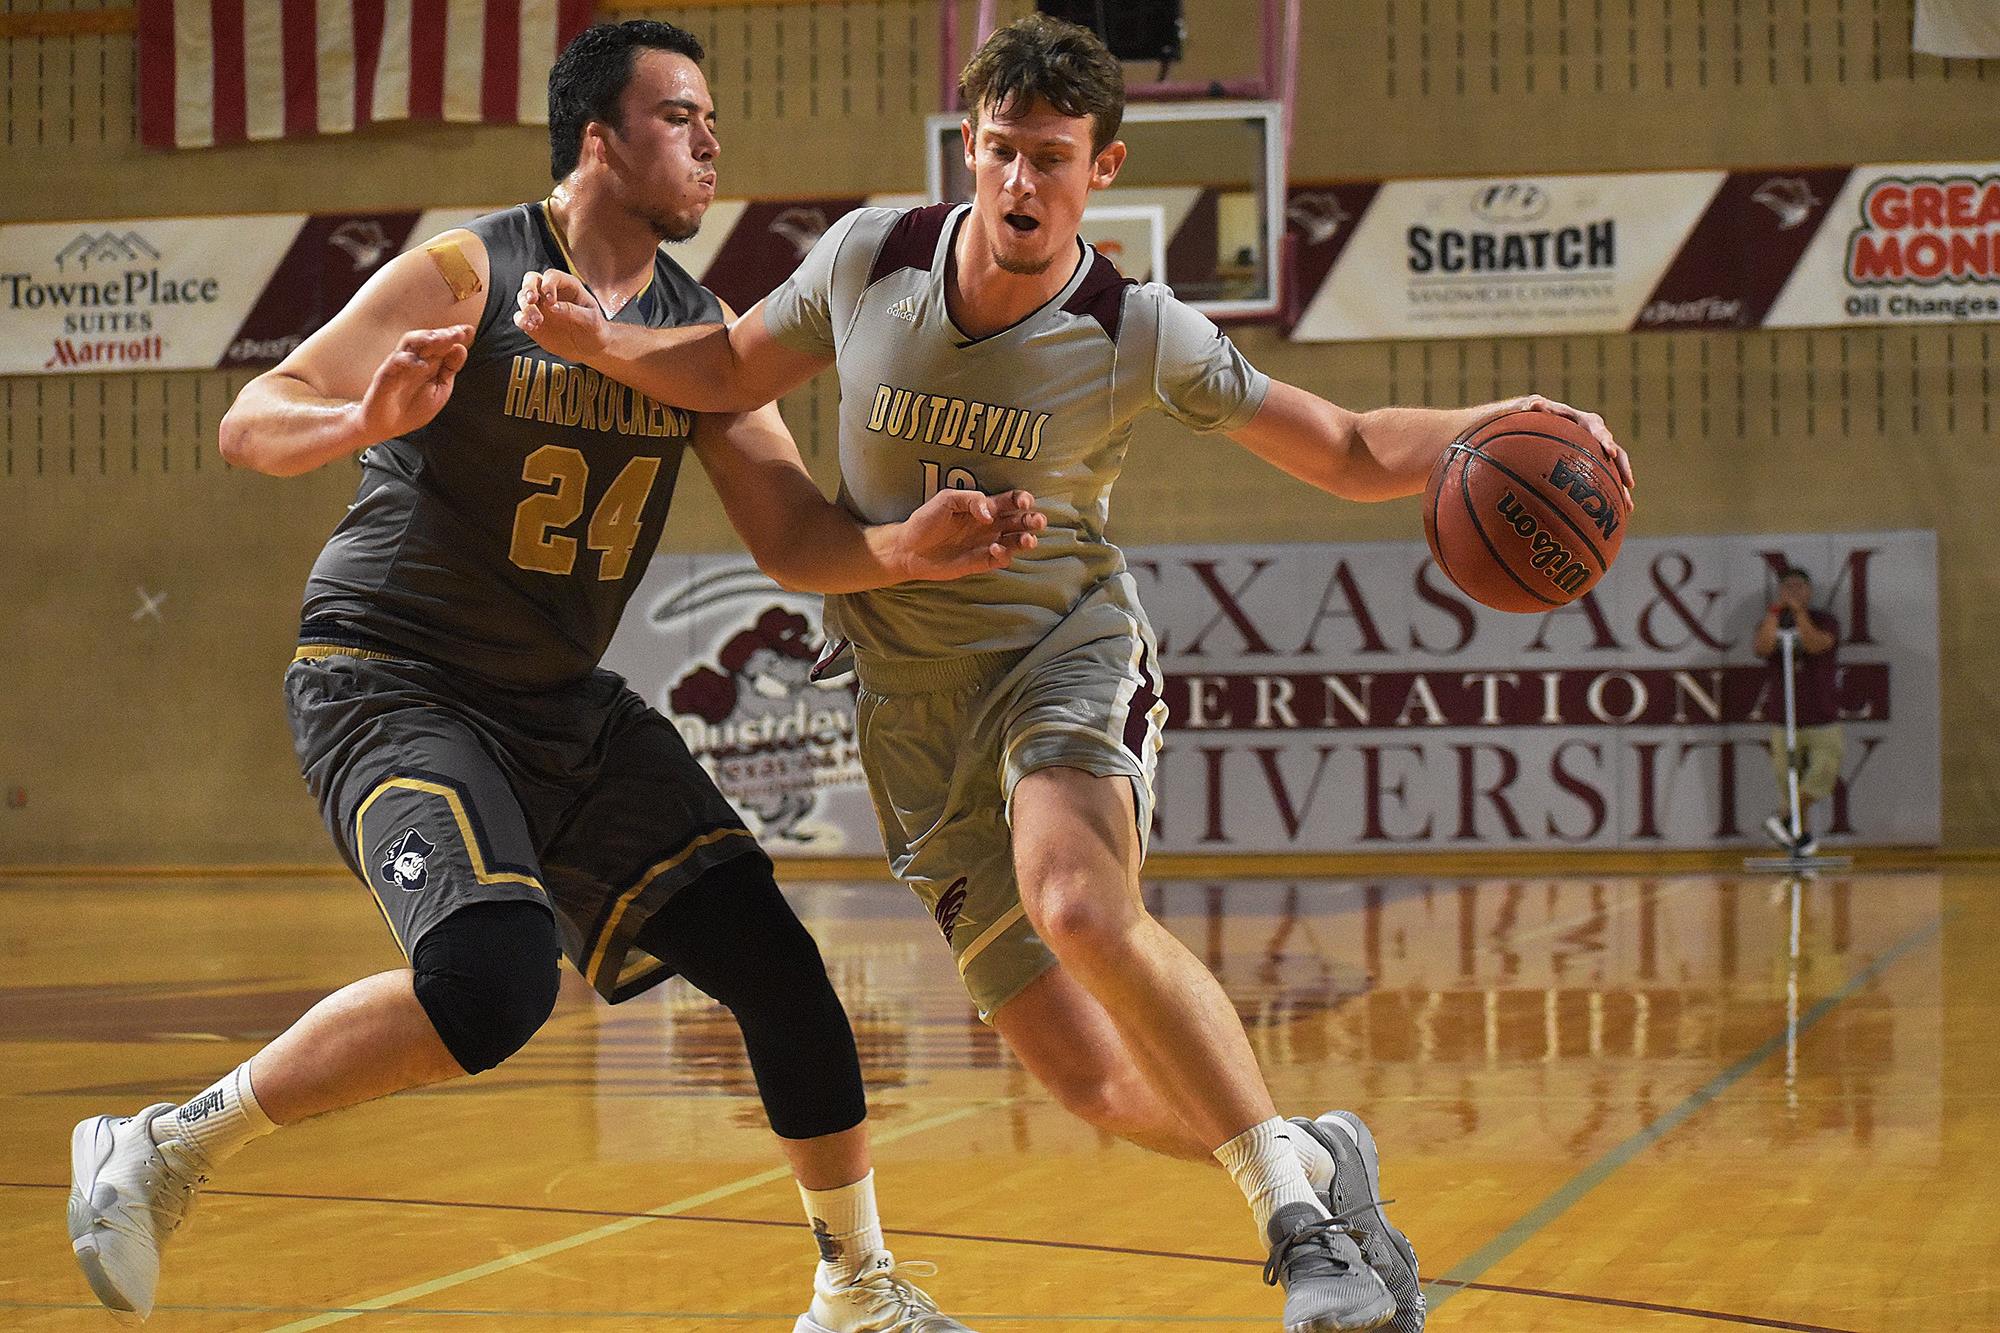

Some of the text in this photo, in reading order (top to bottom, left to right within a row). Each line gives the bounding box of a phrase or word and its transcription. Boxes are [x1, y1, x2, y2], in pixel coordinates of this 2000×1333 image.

[1407, 218, 1615, 273] SCRATCH
[1854, 232, 2000, 278] MON
[1, 268, 220, 310] TownePlace
[1846, 295, 1879, 316] Oil
[64, 312, 153, 335] SUITES
[887, 306, 917, 322] adidas
[46, 336, 163, 368] Marriott
[866, 383, 1052, 461] DUSTDEVILS
[508, 444, 661, 582] 24
[1549, 458, 1620, 541] NCAA
[1496, 489, 1593, 595] Wilson
